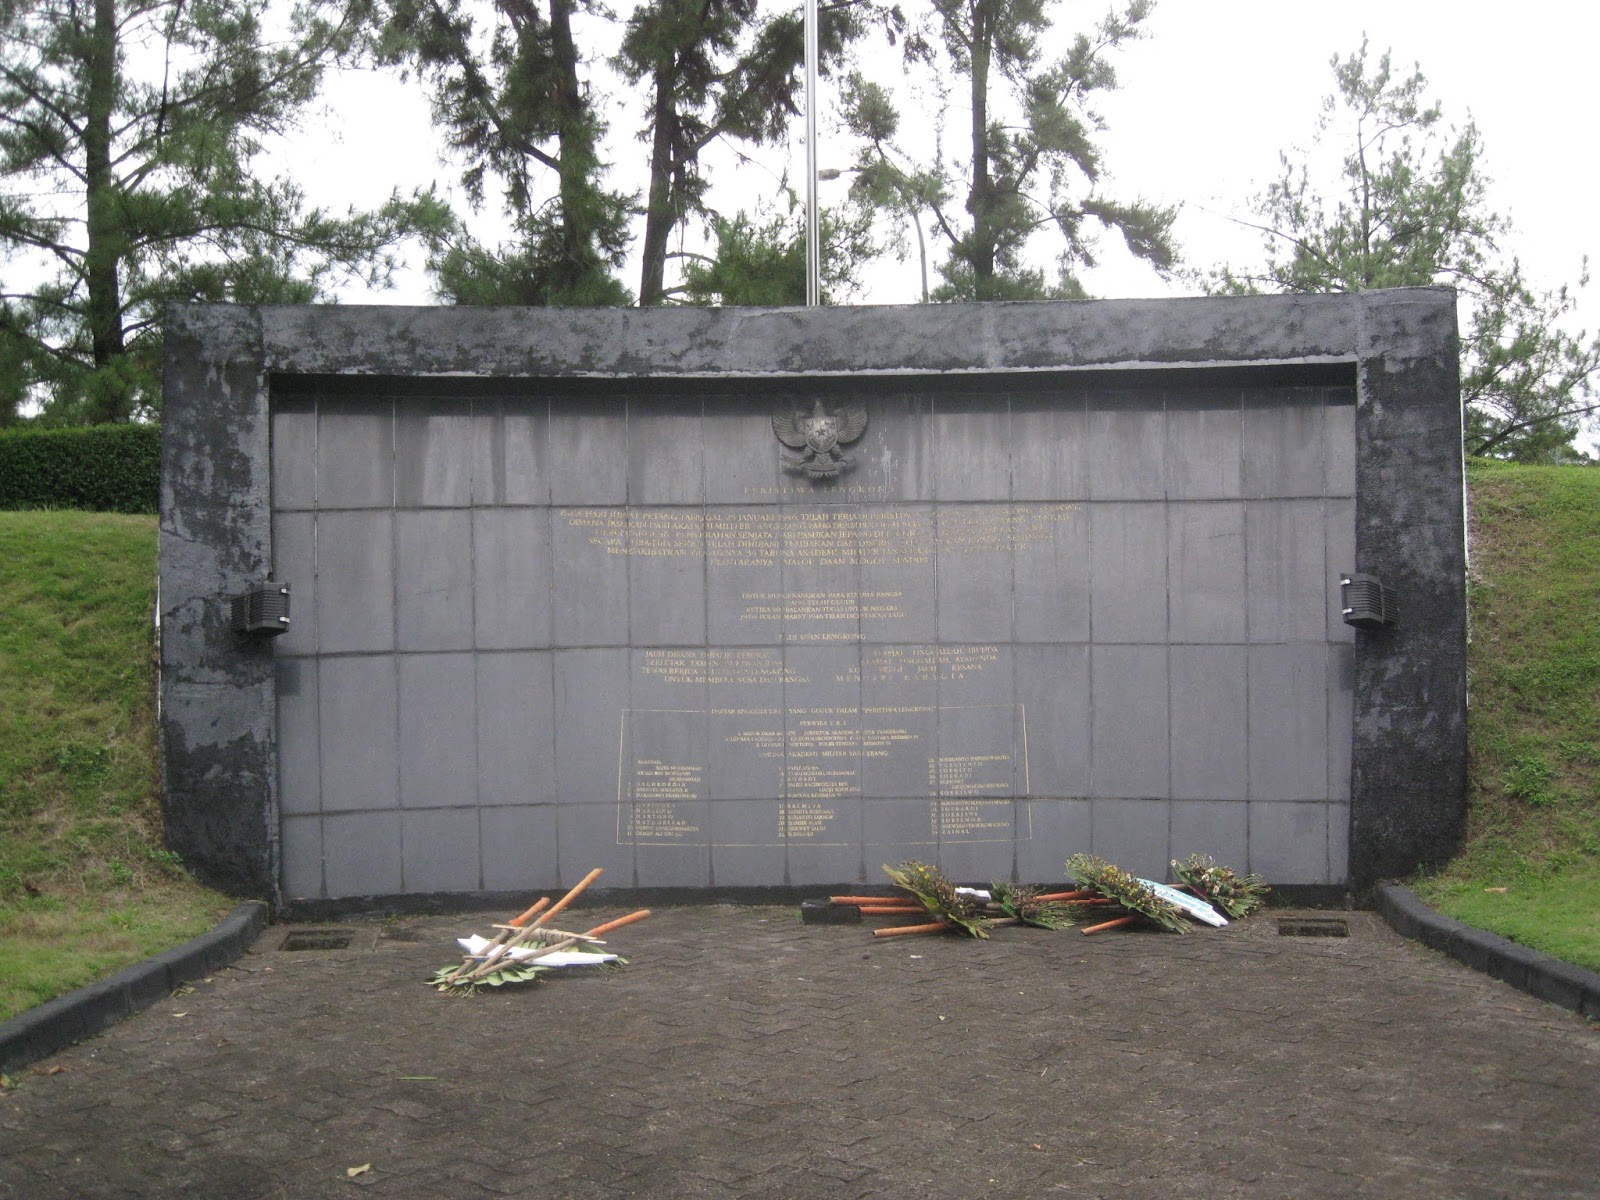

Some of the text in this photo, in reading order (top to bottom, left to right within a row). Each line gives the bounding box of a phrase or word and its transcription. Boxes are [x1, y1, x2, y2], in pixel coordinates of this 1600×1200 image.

[823, 485, 896, 493] LENGKON
[738, 514, 775, 522] JANUARI
[797, 531, 837, 539] PASUKAN
[819, 558, 846, 566] DAAN
